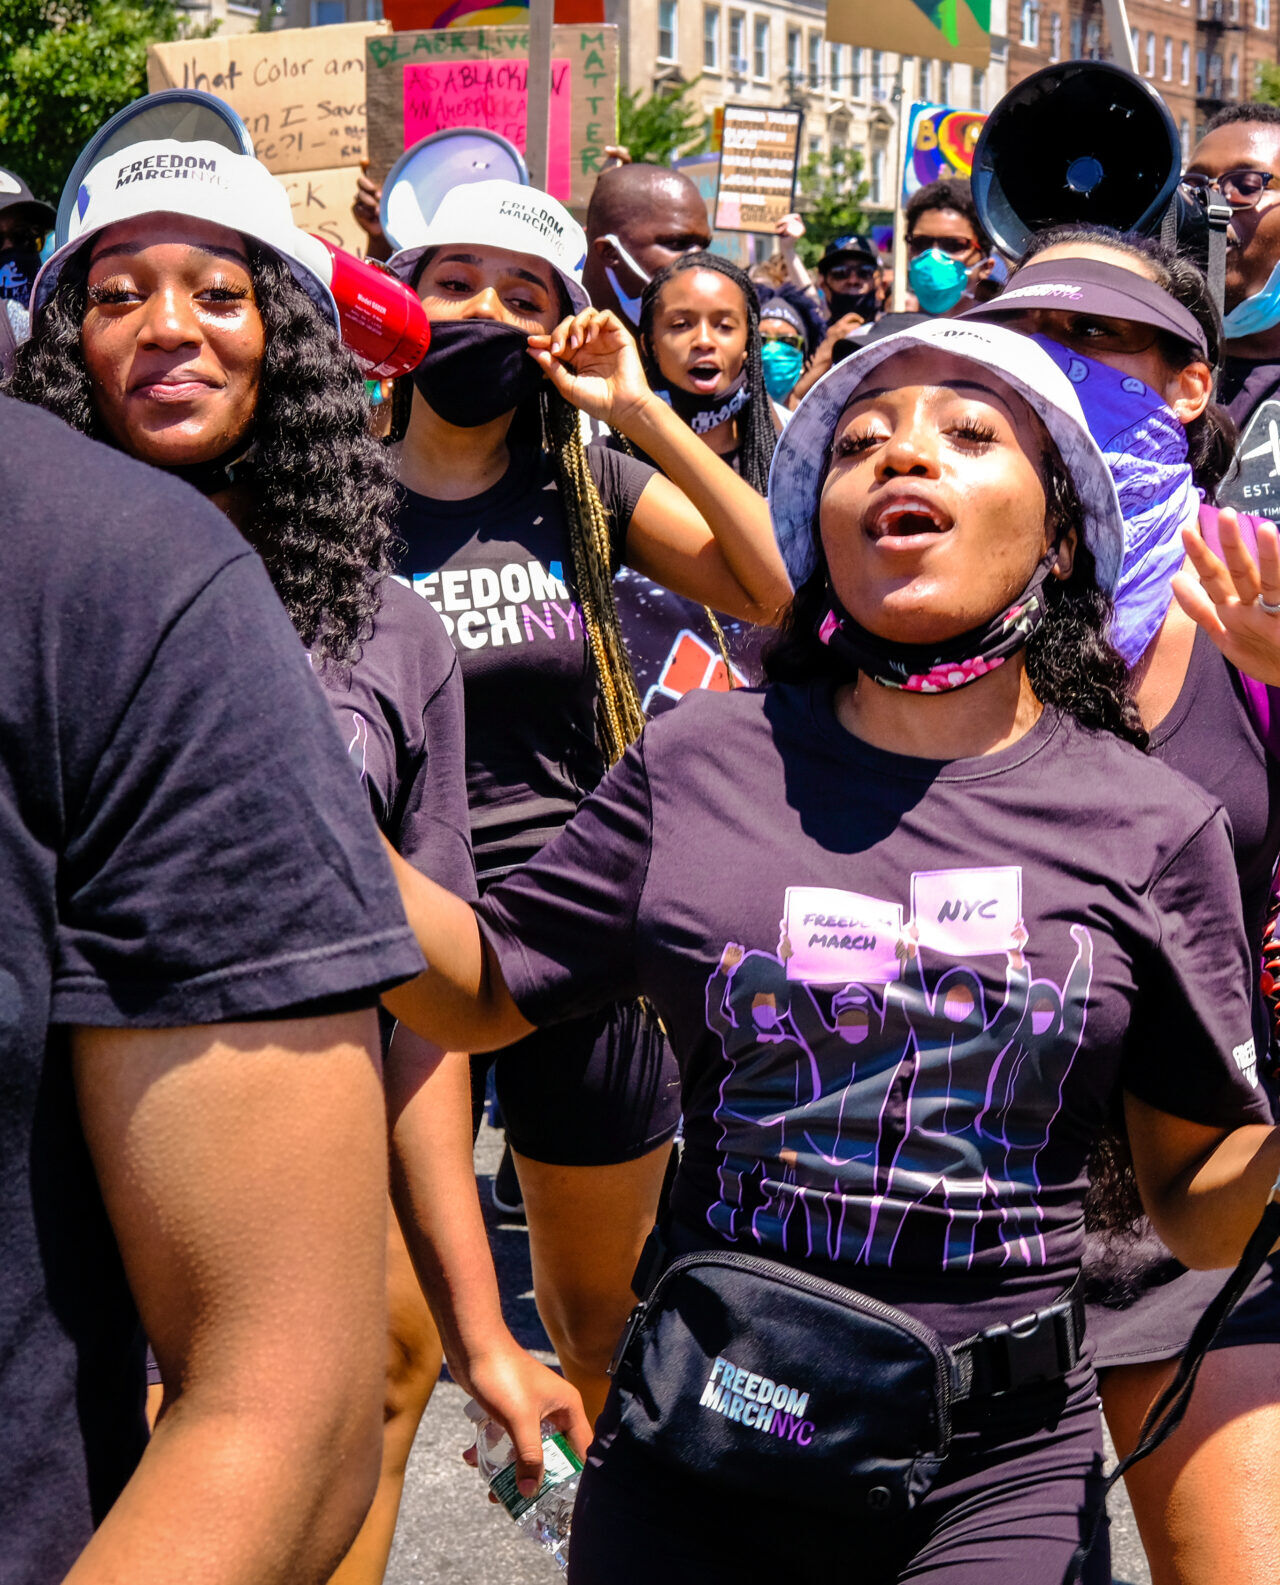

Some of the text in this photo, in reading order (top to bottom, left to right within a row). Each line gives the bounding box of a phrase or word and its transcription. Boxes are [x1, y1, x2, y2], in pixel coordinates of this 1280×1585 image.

[183, 57, 242, 89] hat
[253, 57, 313, 87] Color
[580, 32, 607, 175] MATTER
[115, 169, 222, 190] MARCHNY
[117, 154, 217, 179] FREEDOM
[1243, 482, 1275, 498] EST.
[391, 560, 570, 613] EEDOM
[440, 602, 589, 651] CHNY
[937, 898, 999, 924] NYC
[808, 933, 877, 951] MARCH
[708, 1355, 811, 1419] FREEDOM
[698, 1380, 816, 1447] MARCHNYC
